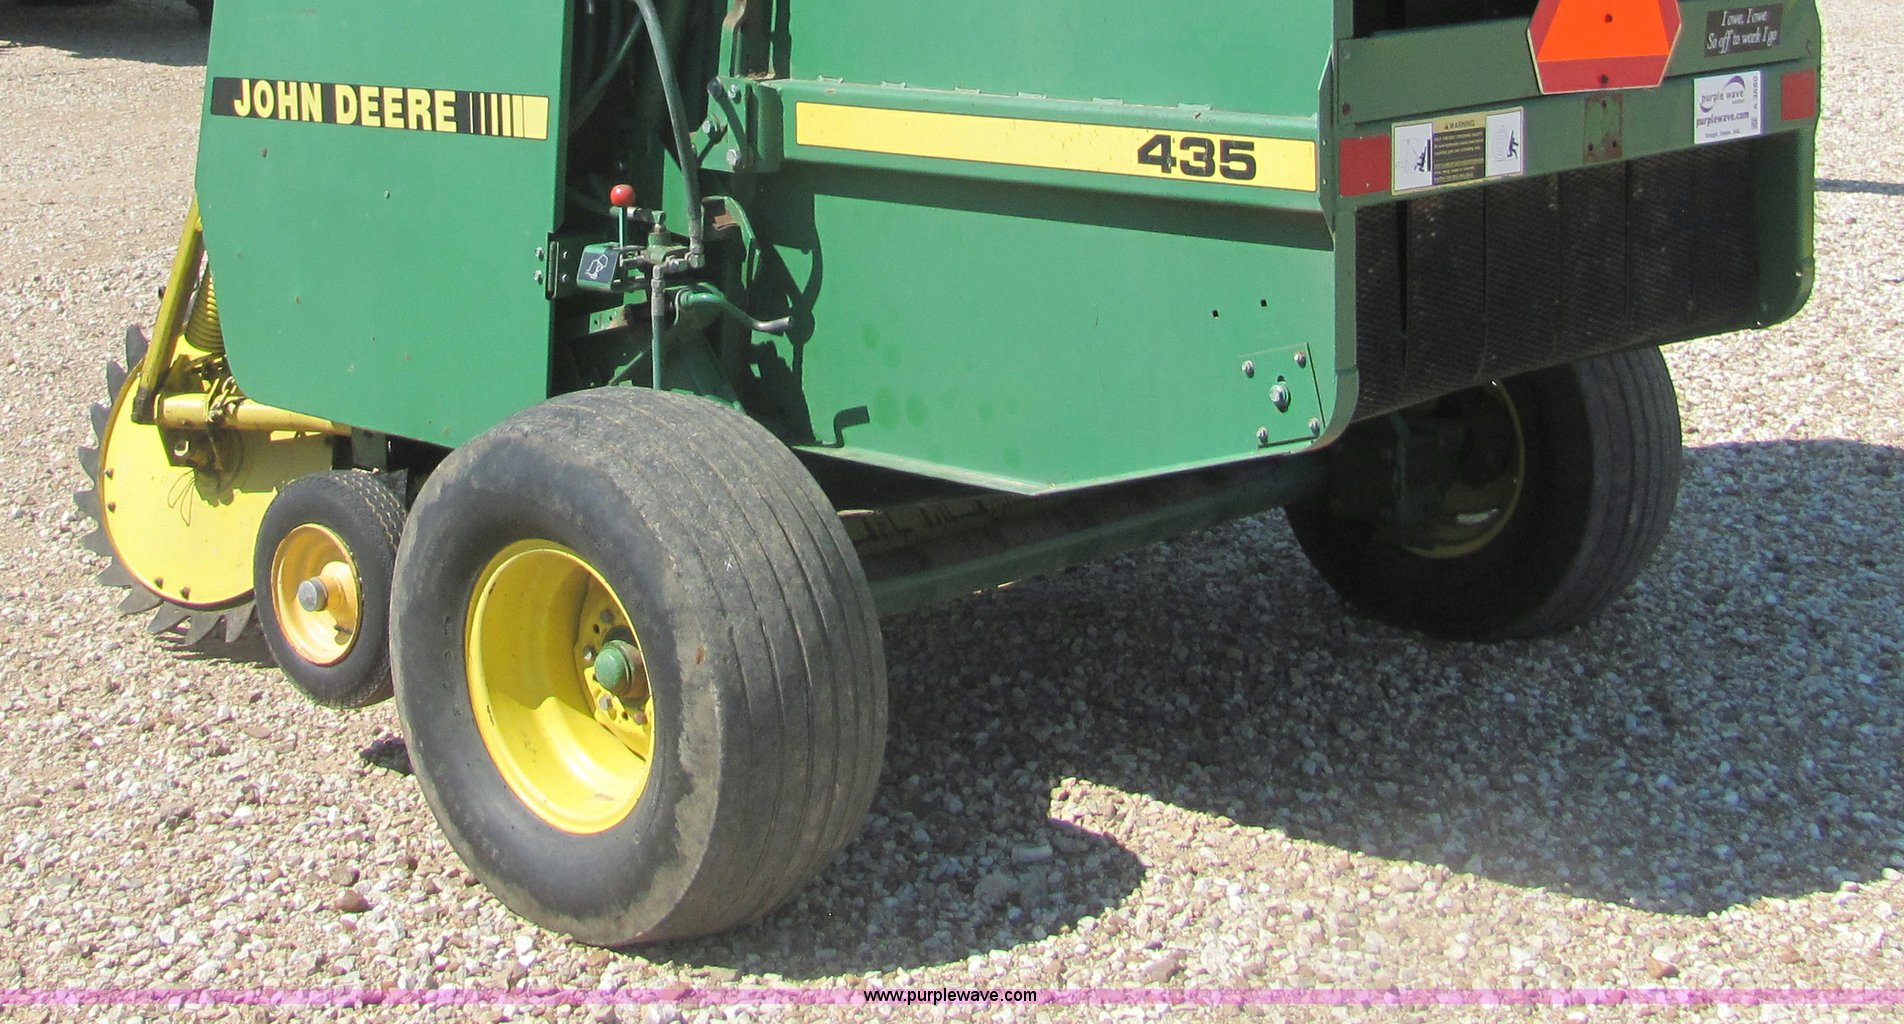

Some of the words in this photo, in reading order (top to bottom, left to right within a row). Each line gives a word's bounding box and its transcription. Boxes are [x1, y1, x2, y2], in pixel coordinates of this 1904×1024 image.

[1752, 11, 1768, 23] owe
[1707, 33, 1717, 49] So
[1718, 29, 1733, 53] off
[1732, 33, 1740, 46] to
[1741, 27, 1761, 44] work
[1767, 30, 1777, 47] go
[1701, 91, 1725, 103] purple
[1726, 90, 1744, 99] wave
[234, 78, 323, 123] JOHN
[335, 83, 457, 133] DEERE
[1450, 120, 1476, 128] WARNING
[1696, 112, 1749, 129] purplewave.com
[1137, 134, 1257, 181] 435
